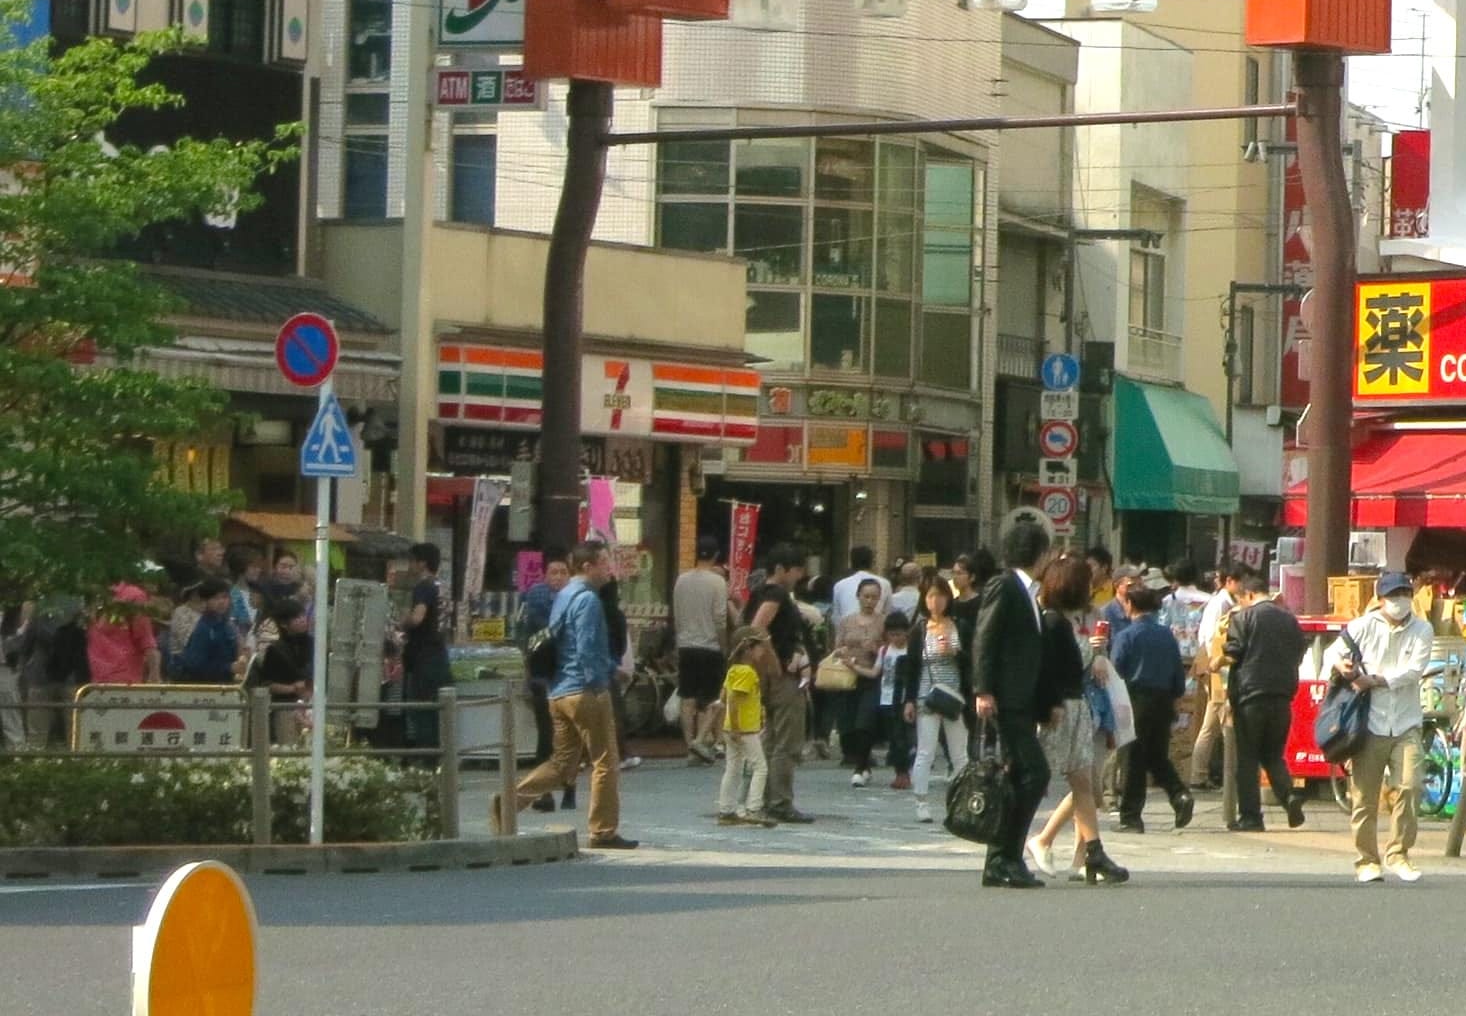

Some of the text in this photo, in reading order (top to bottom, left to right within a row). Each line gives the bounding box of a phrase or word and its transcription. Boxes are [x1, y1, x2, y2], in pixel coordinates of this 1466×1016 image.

[440, 77, 467, 99] ATM
[476, 76, 496, 99] 酒
[1364, 291, 1425, 386] 薬
[1047, 498, 1068, 514] 20
